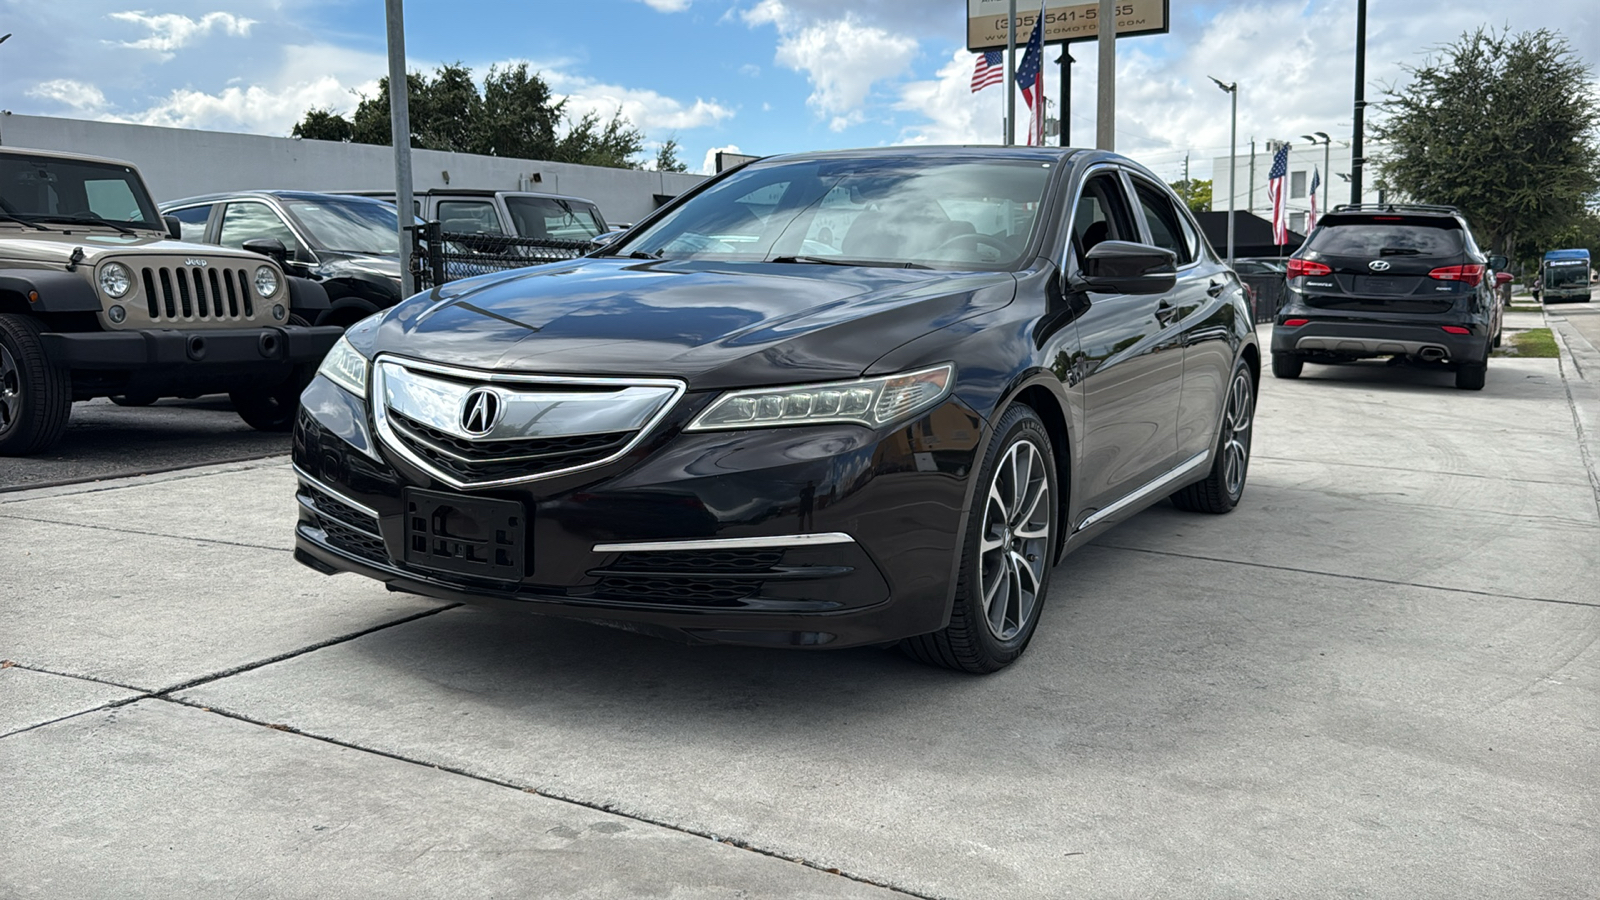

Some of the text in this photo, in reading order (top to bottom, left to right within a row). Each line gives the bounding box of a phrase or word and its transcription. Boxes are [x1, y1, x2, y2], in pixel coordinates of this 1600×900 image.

[995, 4, 1134, 31] (305 541-55
[185, 257, 207, 267] Jeep
